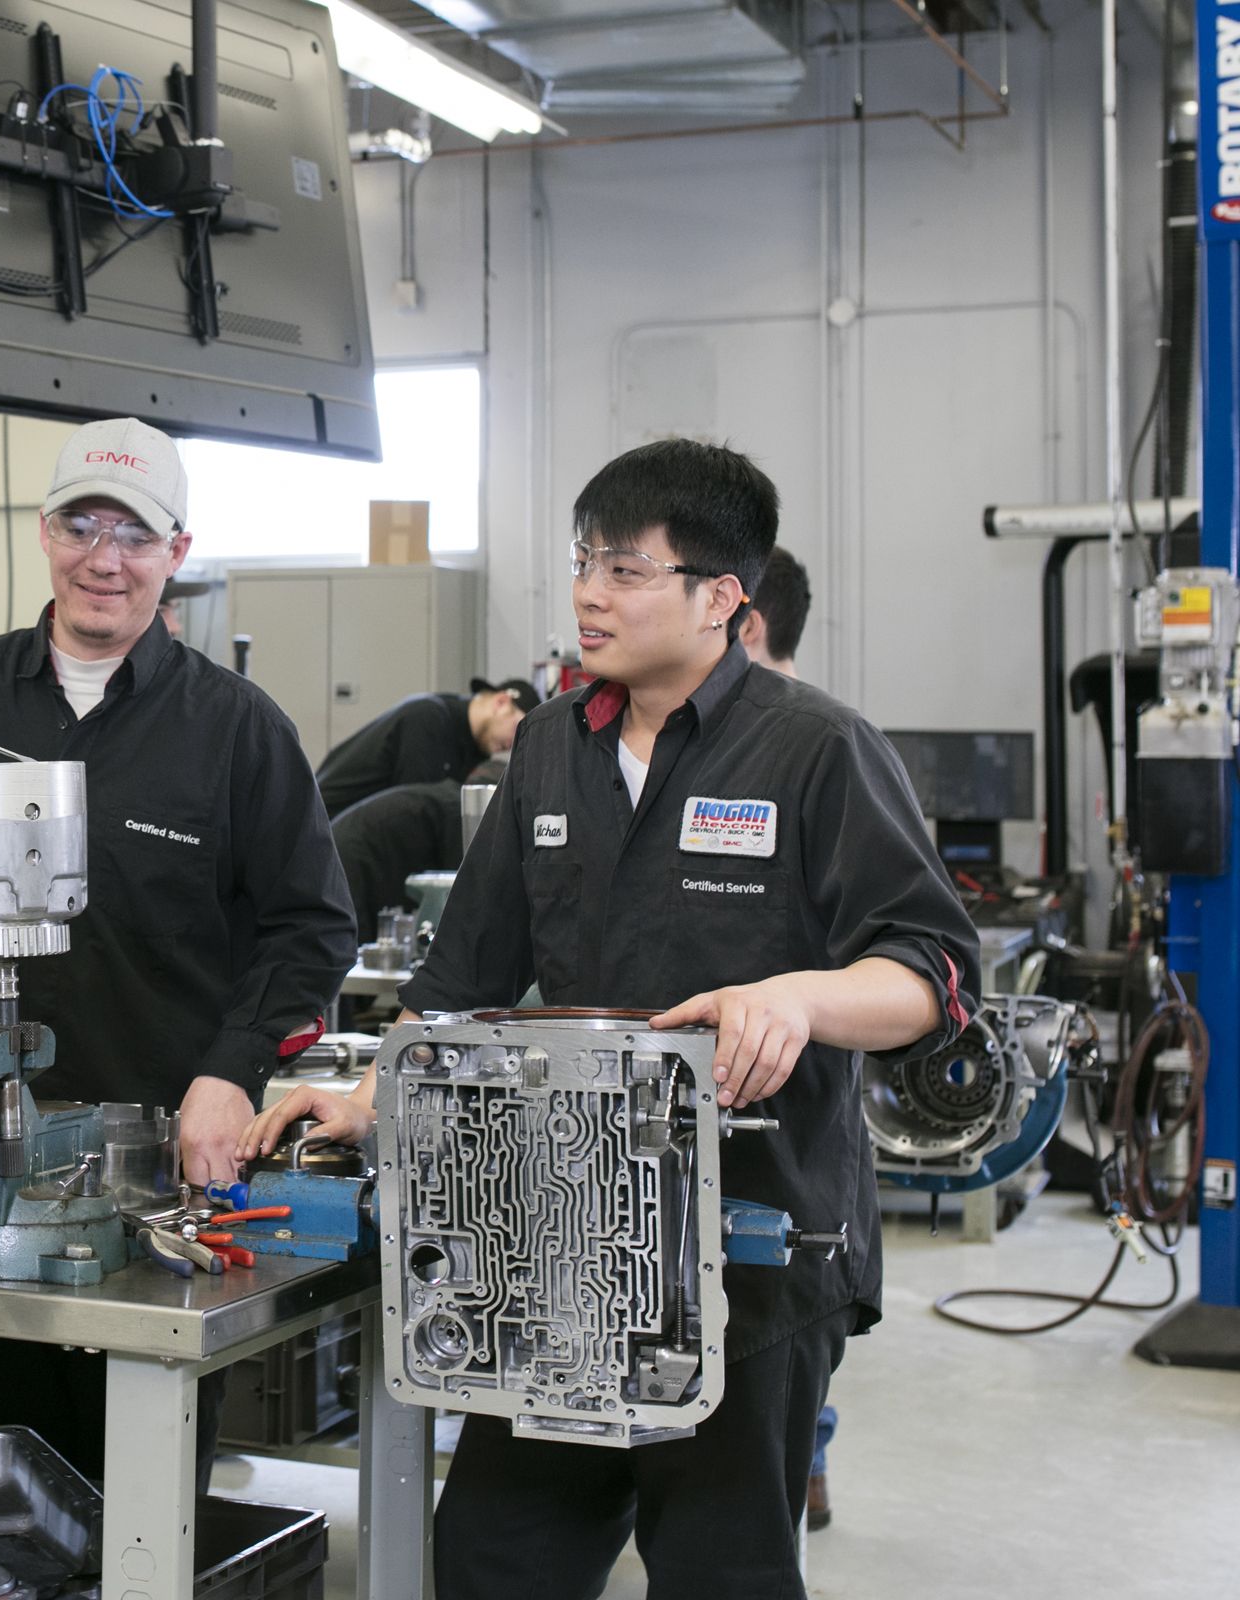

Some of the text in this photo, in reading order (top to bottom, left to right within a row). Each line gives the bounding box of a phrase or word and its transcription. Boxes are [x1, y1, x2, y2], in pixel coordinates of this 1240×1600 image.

[85, 450, 151, 474] GMC
[693, 801, 771, 823] HOGAN
[125, 819, 200, 845] Certified Service
[691, 820, 765, 831] chev.com
[682, 878, 765, 894] Certified Service
